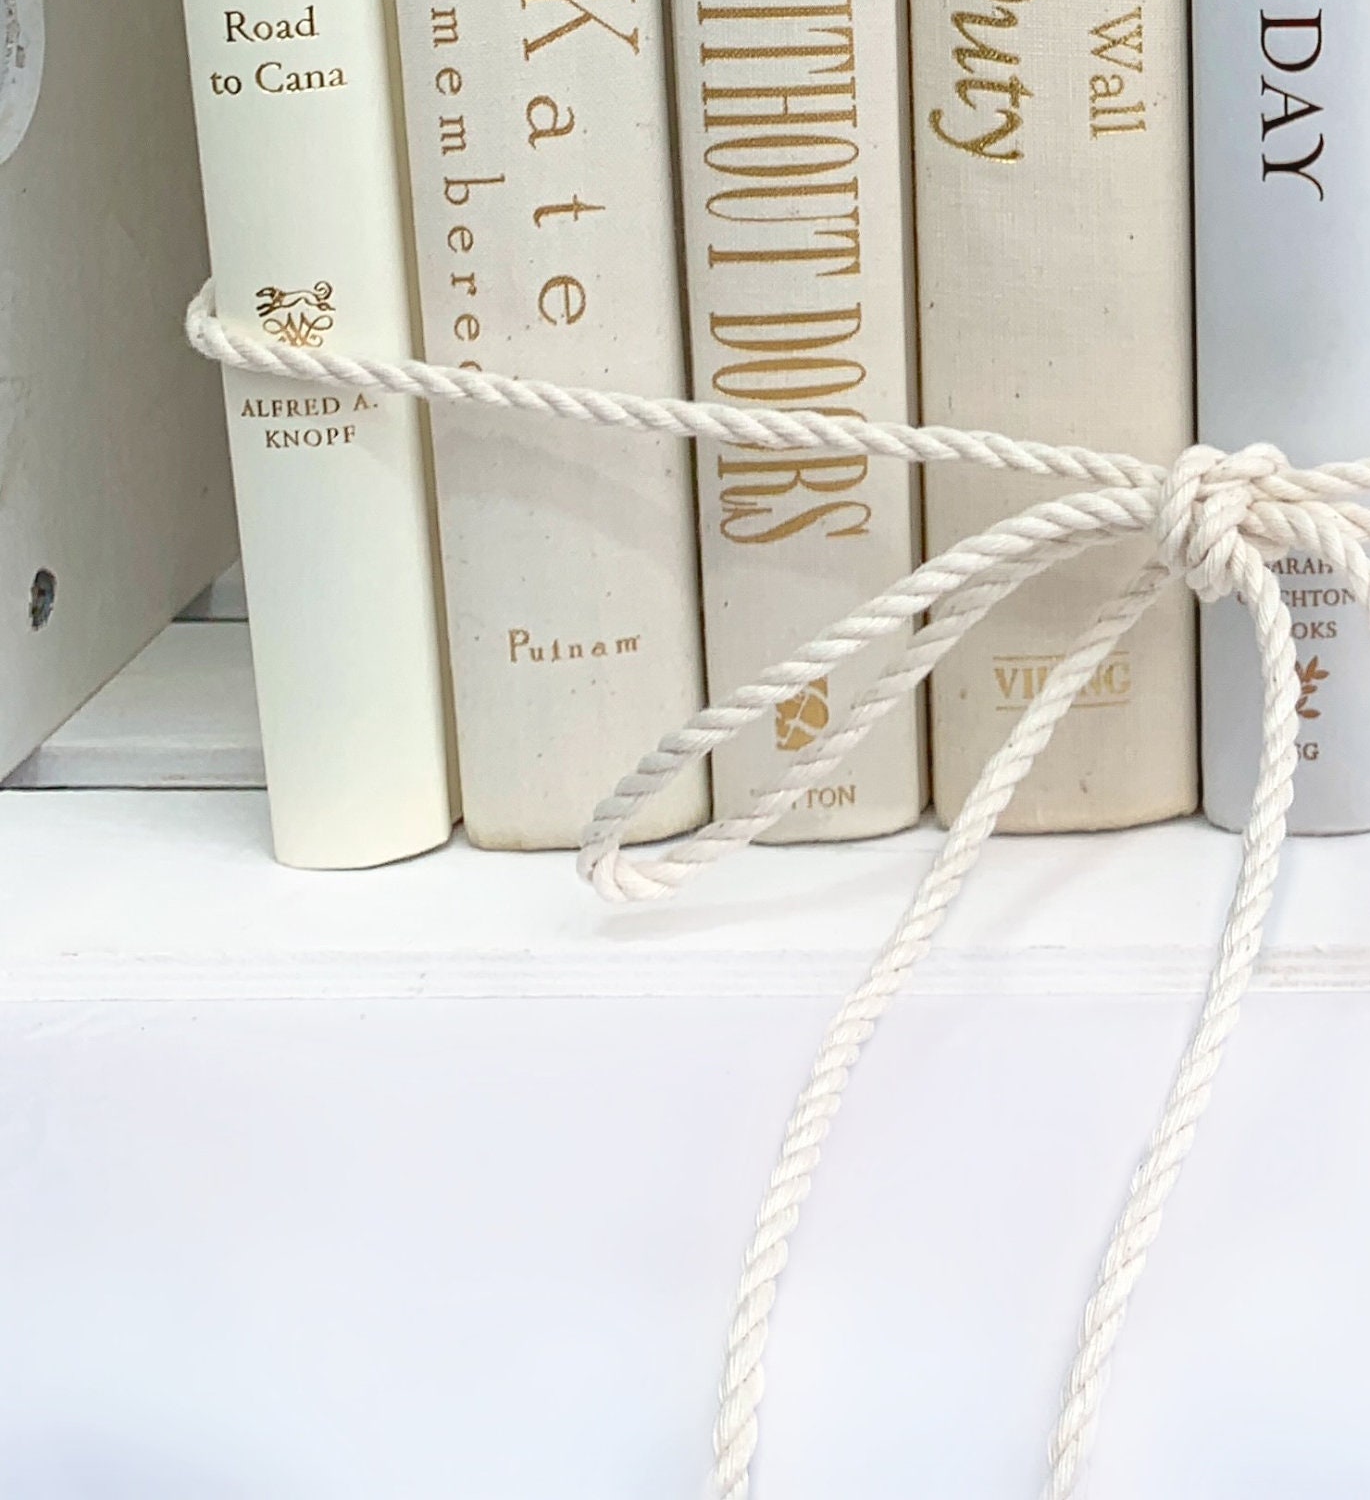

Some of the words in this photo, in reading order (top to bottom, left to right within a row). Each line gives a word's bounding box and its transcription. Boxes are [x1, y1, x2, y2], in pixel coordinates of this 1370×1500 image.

[224, 6, 319, 42] Road
[211, 71, 242, 95] to
[255, 65, 347, 93] Cana
[1089, 6, 1147, 139] Wall
[242, 397, 340, 419] ALFRED
[350, 393, 379, 414] A.
[265, 425, 356, 449] KNOPF
[710, 302, 872, 545] DORS
[508, 629, 640, 663] Putnam
[1290, 621, 1337, 639] OKS
